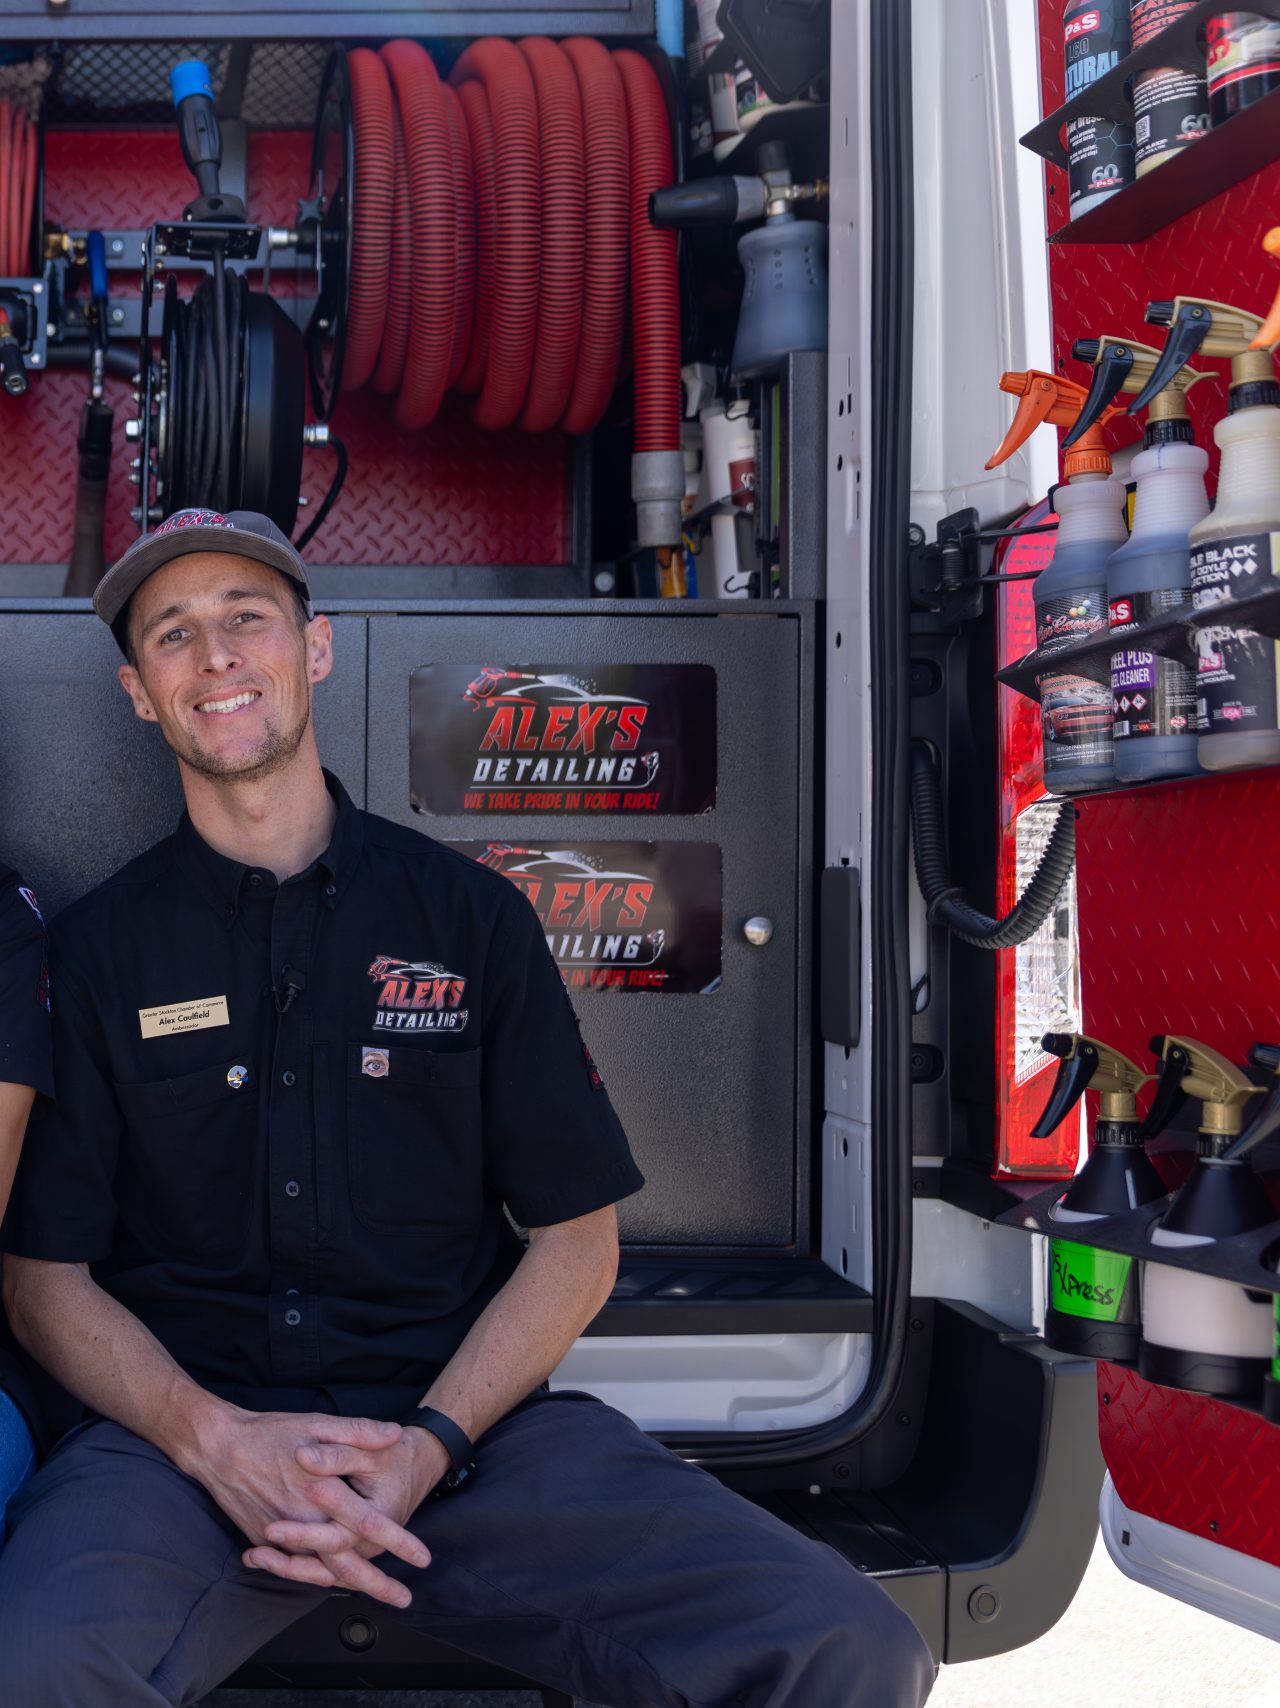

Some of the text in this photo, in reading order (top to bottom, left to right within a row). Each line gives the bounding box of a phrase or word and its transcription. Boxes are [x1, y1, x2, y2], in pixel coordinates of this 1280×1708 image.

[1065, 14, 1098, 40] P&S
[1092, 164, 1118, 184] 60
[1096, 178, 1114, 187] P&S
[1206, 544, 1258, 563] BLACK
[1197, 562, 1228, 576] DOYLE
[1192, 570, 1229, 588] ECTION
[1128, 650, 1152, 666] PLUS
[1120, 668, 1150, 686] CLEANER
[478, 703, 648, 755] ALEX'S
[473, 758, 637, 782] DETAILING
[464, 792, 660, 809] WE TAKE PRIDE IN YOUR RIDE!
[526, 879, 654, 932] LEX'S
[570, 970, 586, 986] IN
[590, 970, 627, 986] YOUR
[158, 1010, 210, 1026] Alex Caulfield
[376, 1011, 458, 1028] DETAILING
[172, 1023, 200, 1032] Ambassador
